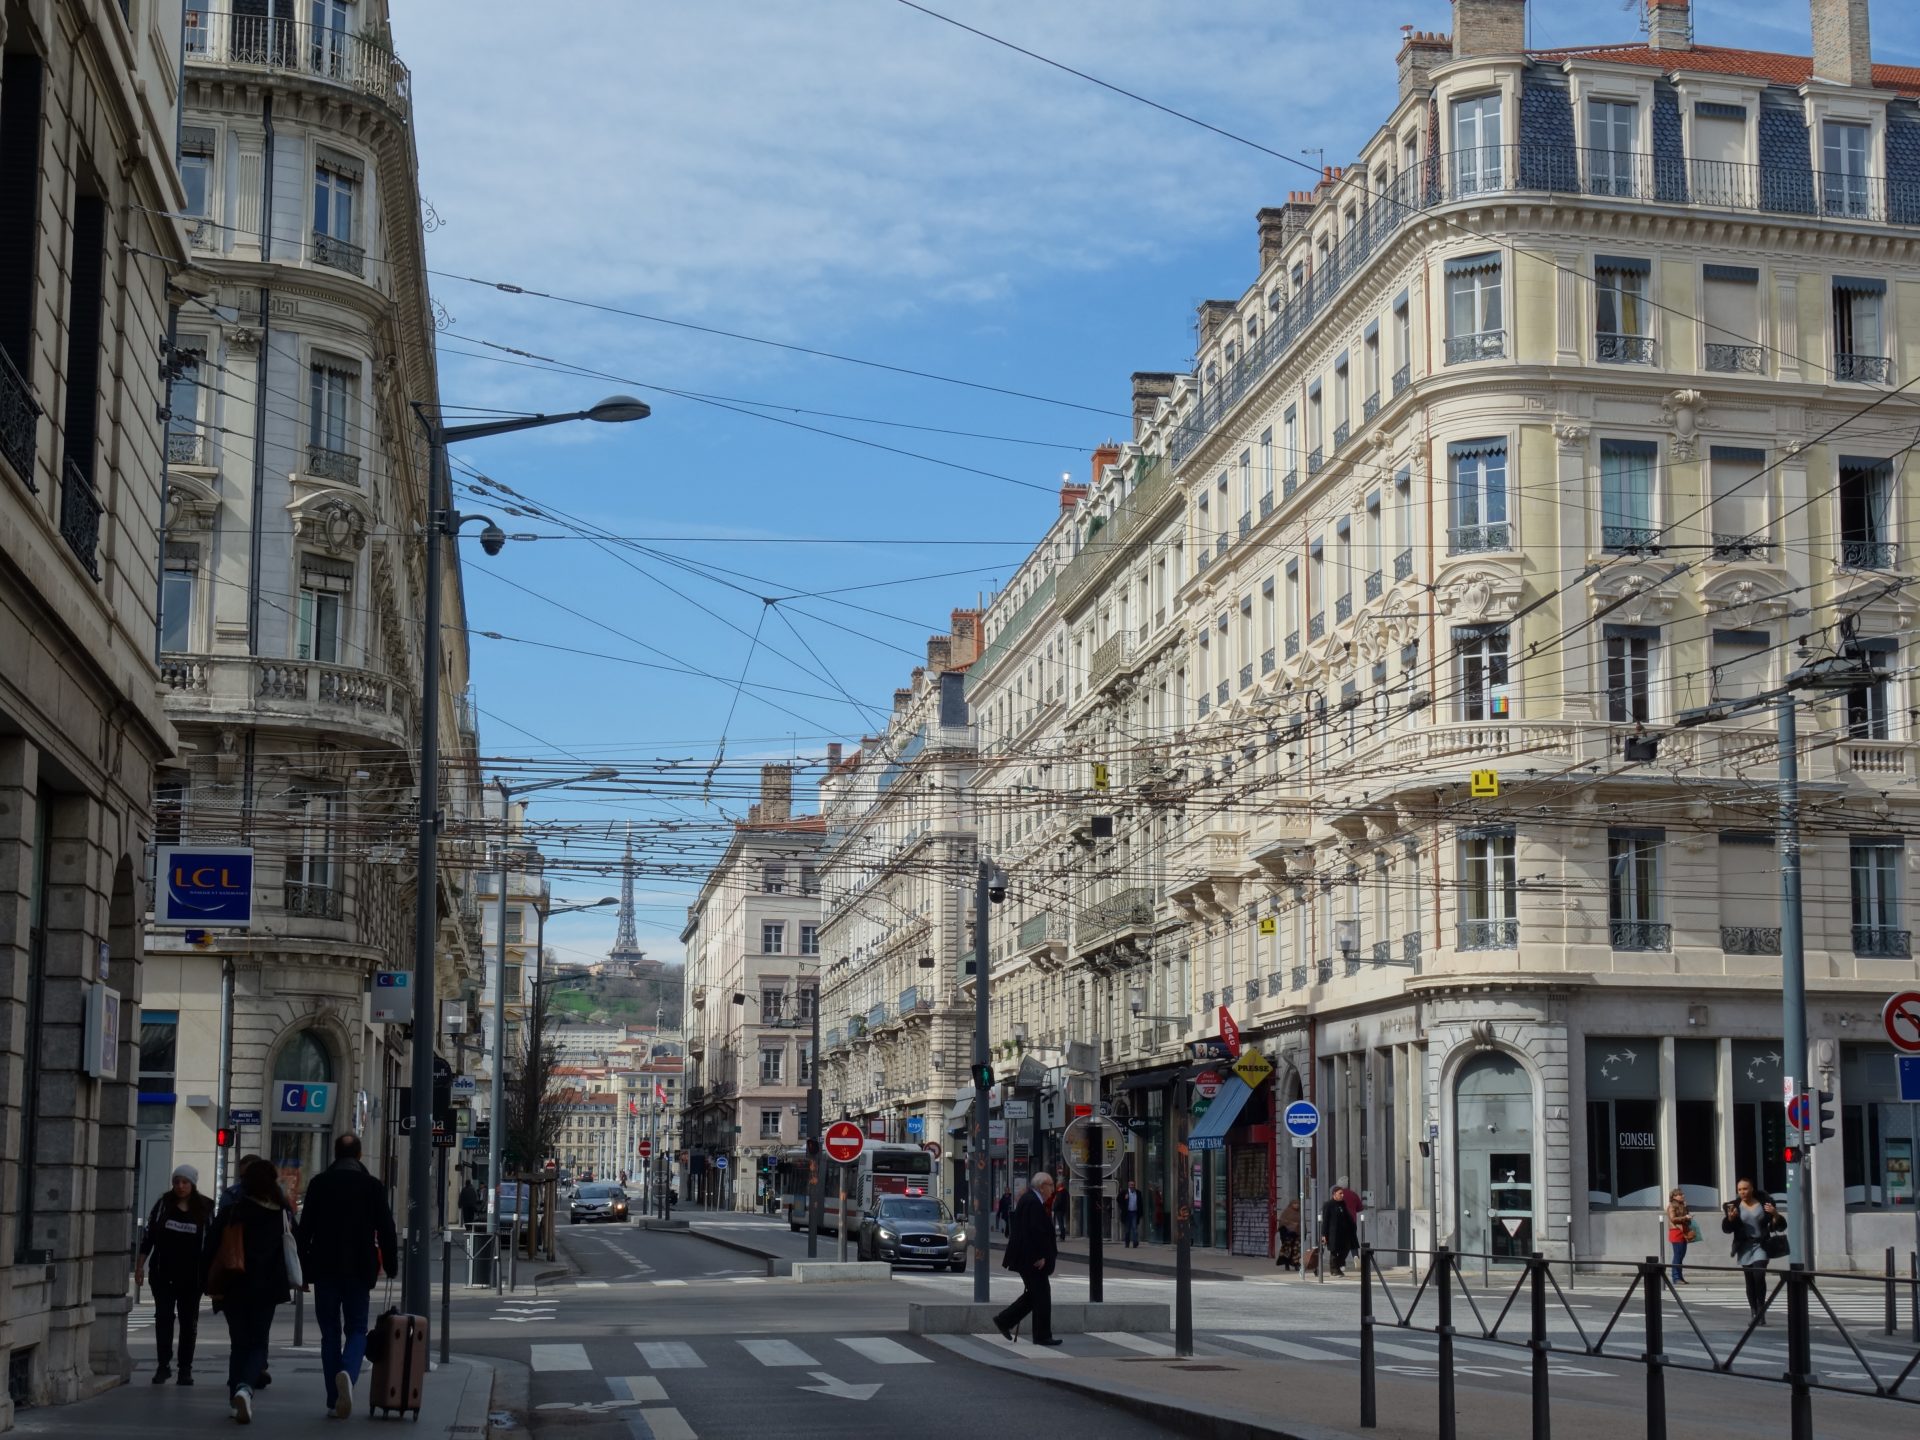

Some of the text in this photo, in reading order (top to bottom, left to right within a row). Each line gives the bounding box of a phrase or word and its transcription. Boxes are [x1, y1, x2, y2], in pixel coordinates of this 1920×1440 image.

[175, 867, 241, 888] LCL
[380, 975, 405, 985] CIC
[1223, 1016, 1235, 1046] TABAC
[1237, 1064, 1270, 1073] PRESSE
[286, 1089, 324, 1108] CIC
[1188, 1139, 1206, 1149] PRESSE
[1620, 1132, 1656, 1146] CONSEIL
